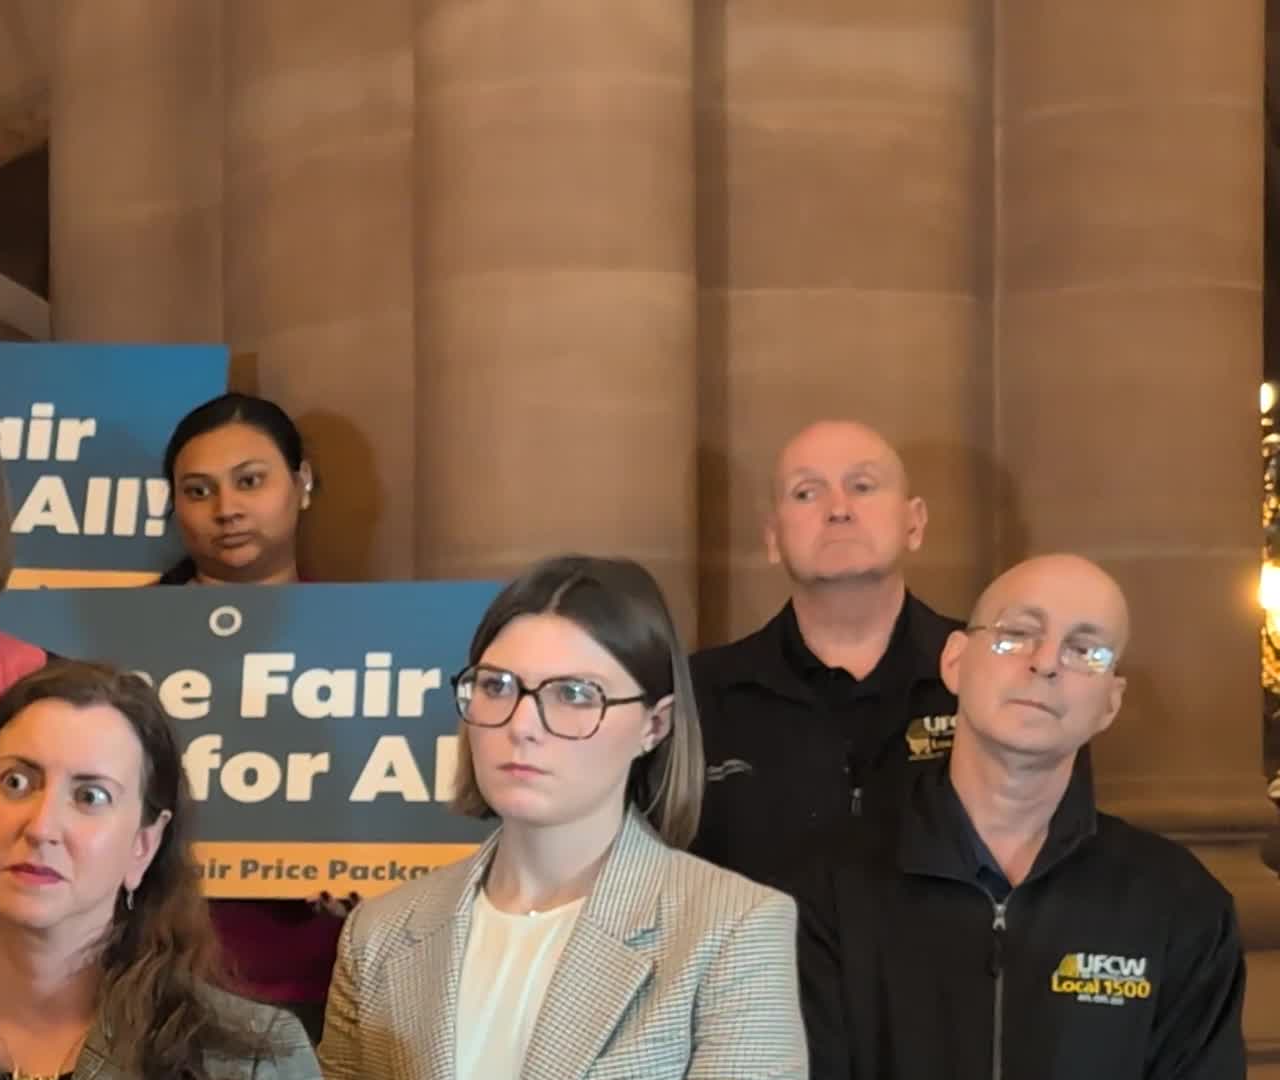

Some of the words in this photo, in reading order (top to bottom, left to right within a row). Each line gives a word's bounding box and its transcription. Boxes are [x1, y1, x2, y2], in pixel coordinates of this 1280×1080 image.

[10, 475, 170, 537] All!
[240, 652, 442, 719] Fair
[181, 734, 330, 803] for
[349, 735, 459, 802] Al
[240, 858, 318, 881] Price
[1052, 974, 1100, 994] Local
[1103, 979, 1152, 998] 1500
[1077, 952, 1147, 978] UFCW
